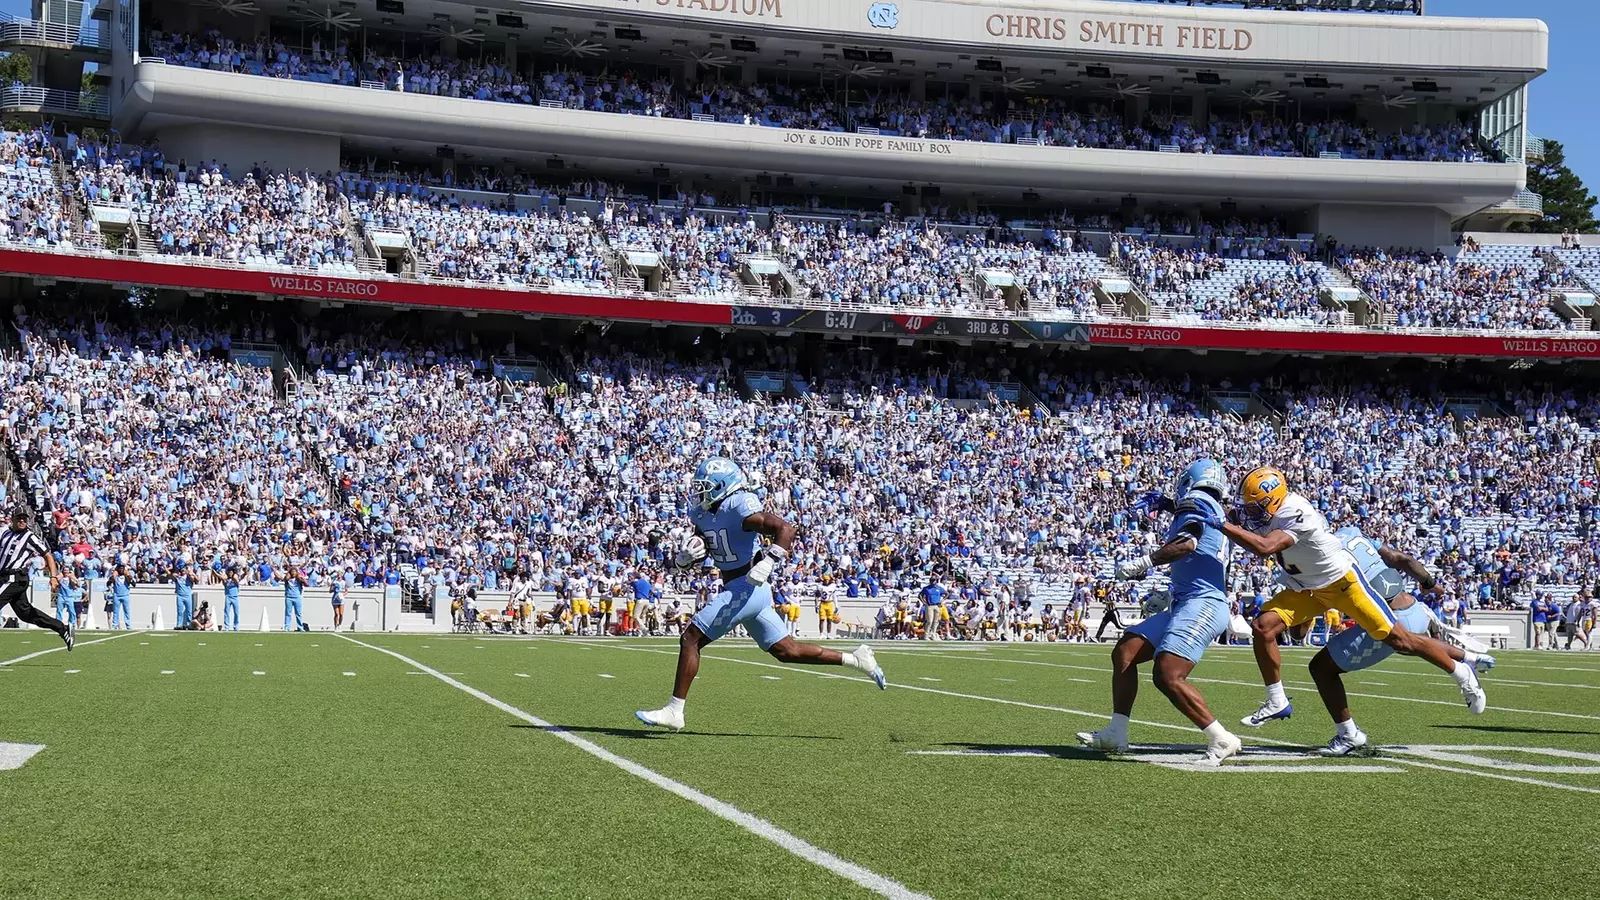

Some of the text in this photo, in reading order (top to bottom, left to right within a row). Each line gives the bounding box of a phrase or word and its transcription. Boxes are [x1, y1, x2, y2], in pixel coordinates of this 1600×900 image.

[656, 0, 782, 17] DIUM
[986, 14, 1252, 50] CHRIS SMITH FIELD
[784, 133, 951, 154] JOY & JOHN POPE FAMILY BOX
[269, 276, 378, 295] WELLS FARGO
[772, 311, 781, 324] 3
[825, 312, 858, 329] 6:47
[905, 316, 922, 329] 40
[967, 321, 1009, 335] 3RD & 6
[1043, 325, 1051, 337] 0
[1090, 327, 1133, 339] WELLS
[1137, 329, 1181, 340] FARGO
[1502, 340, 1597, 352] WELLS FARGO
[1259, 479, 1280, 493] Pitt
[1295, 508, 1304, 523] 2
[703, 528, 738, 563] 21
